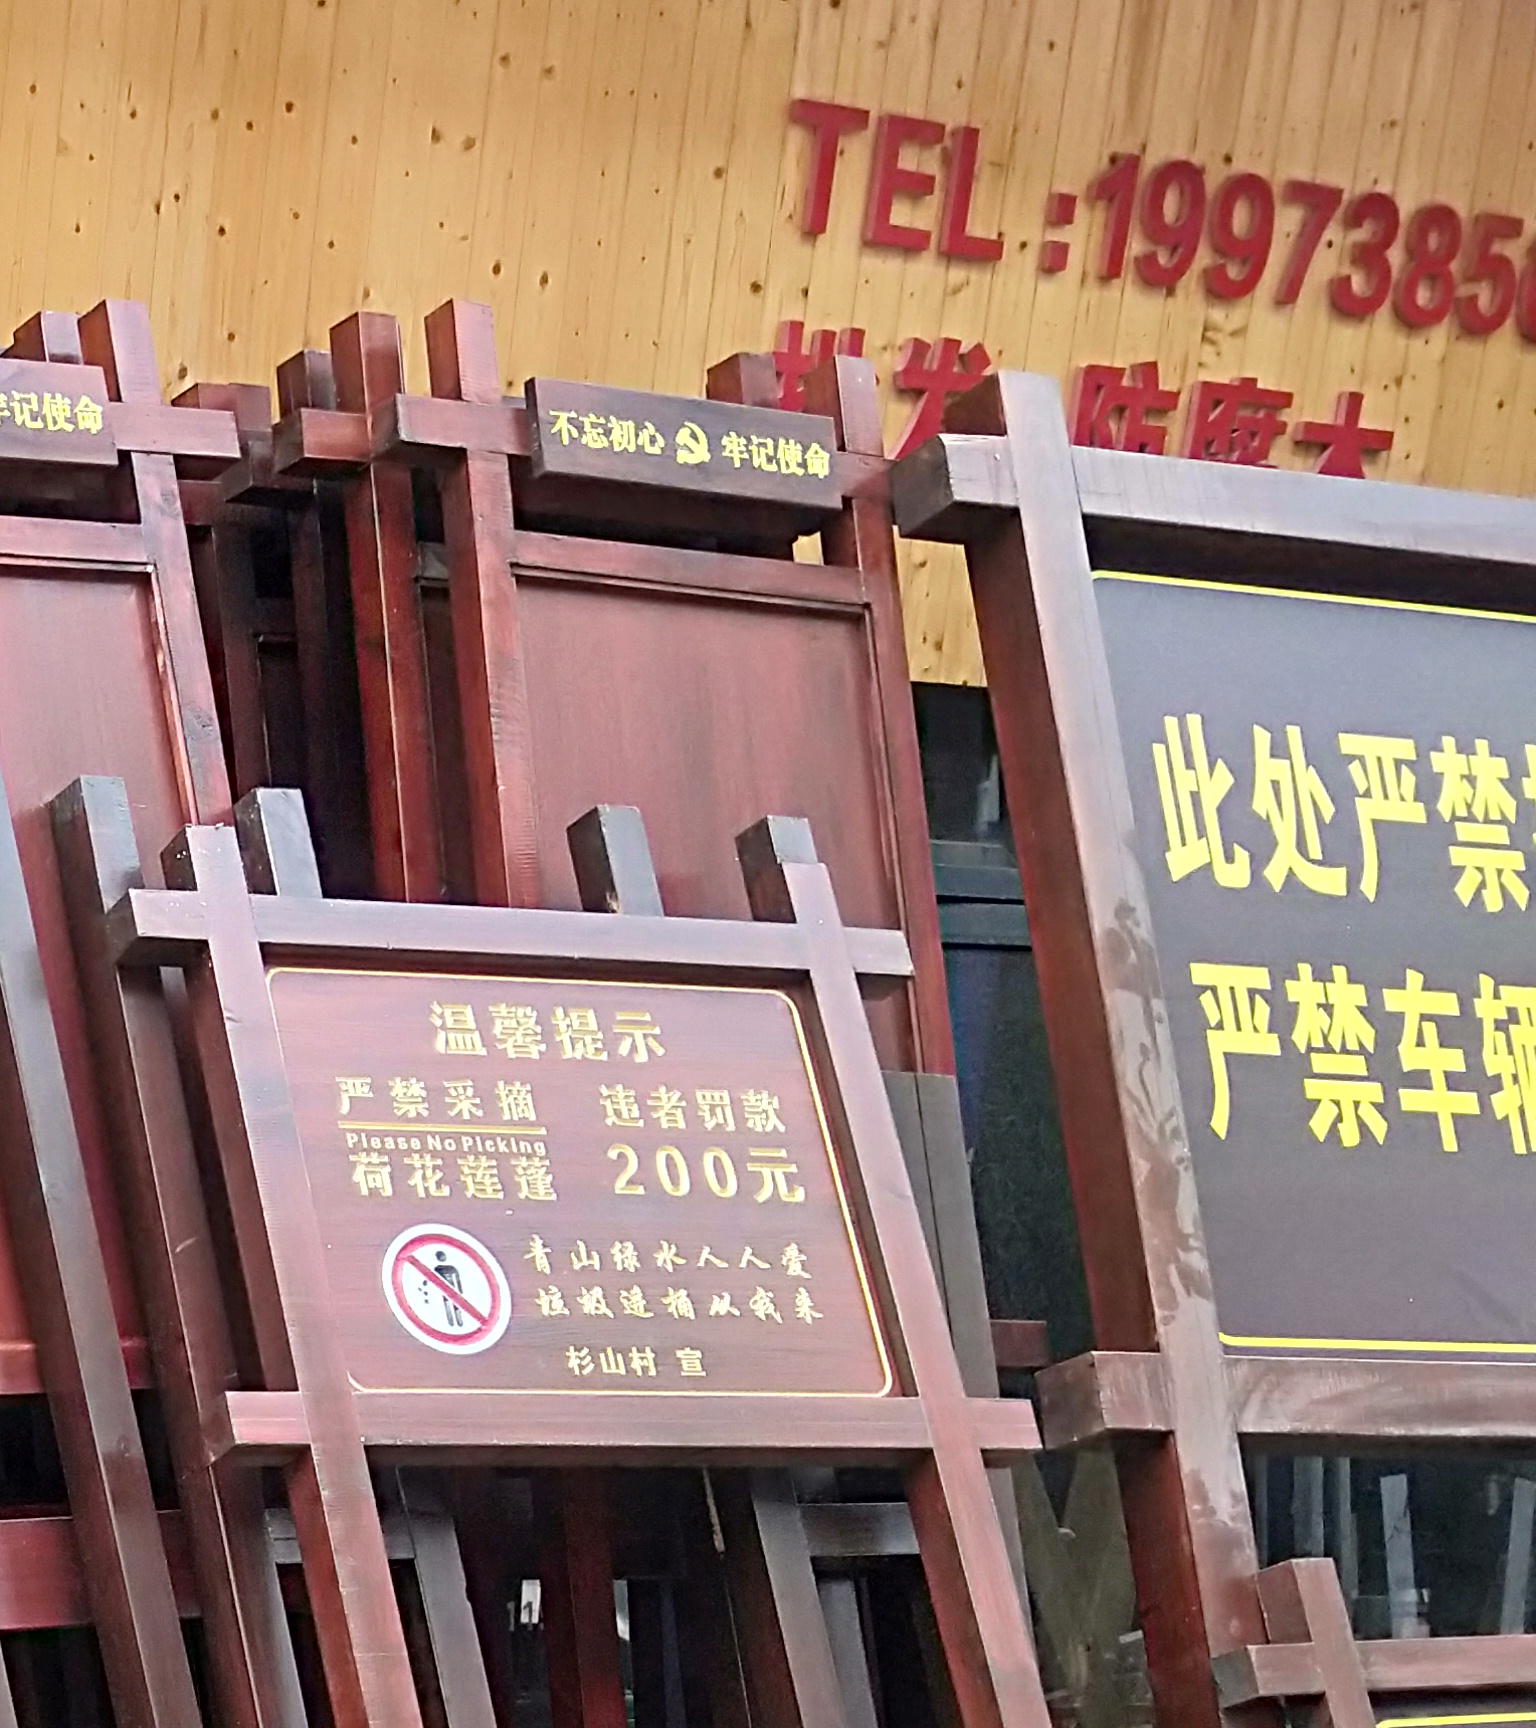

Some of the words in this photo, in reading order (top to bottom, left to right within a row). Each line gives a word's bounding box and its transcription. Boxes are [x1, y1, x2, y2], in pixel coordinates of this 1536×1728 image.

[549, 409, 666, 455] 不忘初心
[722, 430, 832, 479] 牢记使命
[1152, 713, 1536, 912] 此处严禁
[430, 1002, 666, 1063] 温馨提示
[335, 1076, 537, 1121] 严禁采摘
[600, 1084, 785, 1134] 违者罚款
[346, 1132, 421, 1150] Please
[427, 1134, 457, 1152] No
[461, 1136, 547, 1156] Picking
[349, 1152, 558, 1201] 荷花莲蓬
[608, 1145, 805, 1203] 200元
[566, 1346, 657, 1377] 杉山村
[676, 1348, 707, 1377] 宣
